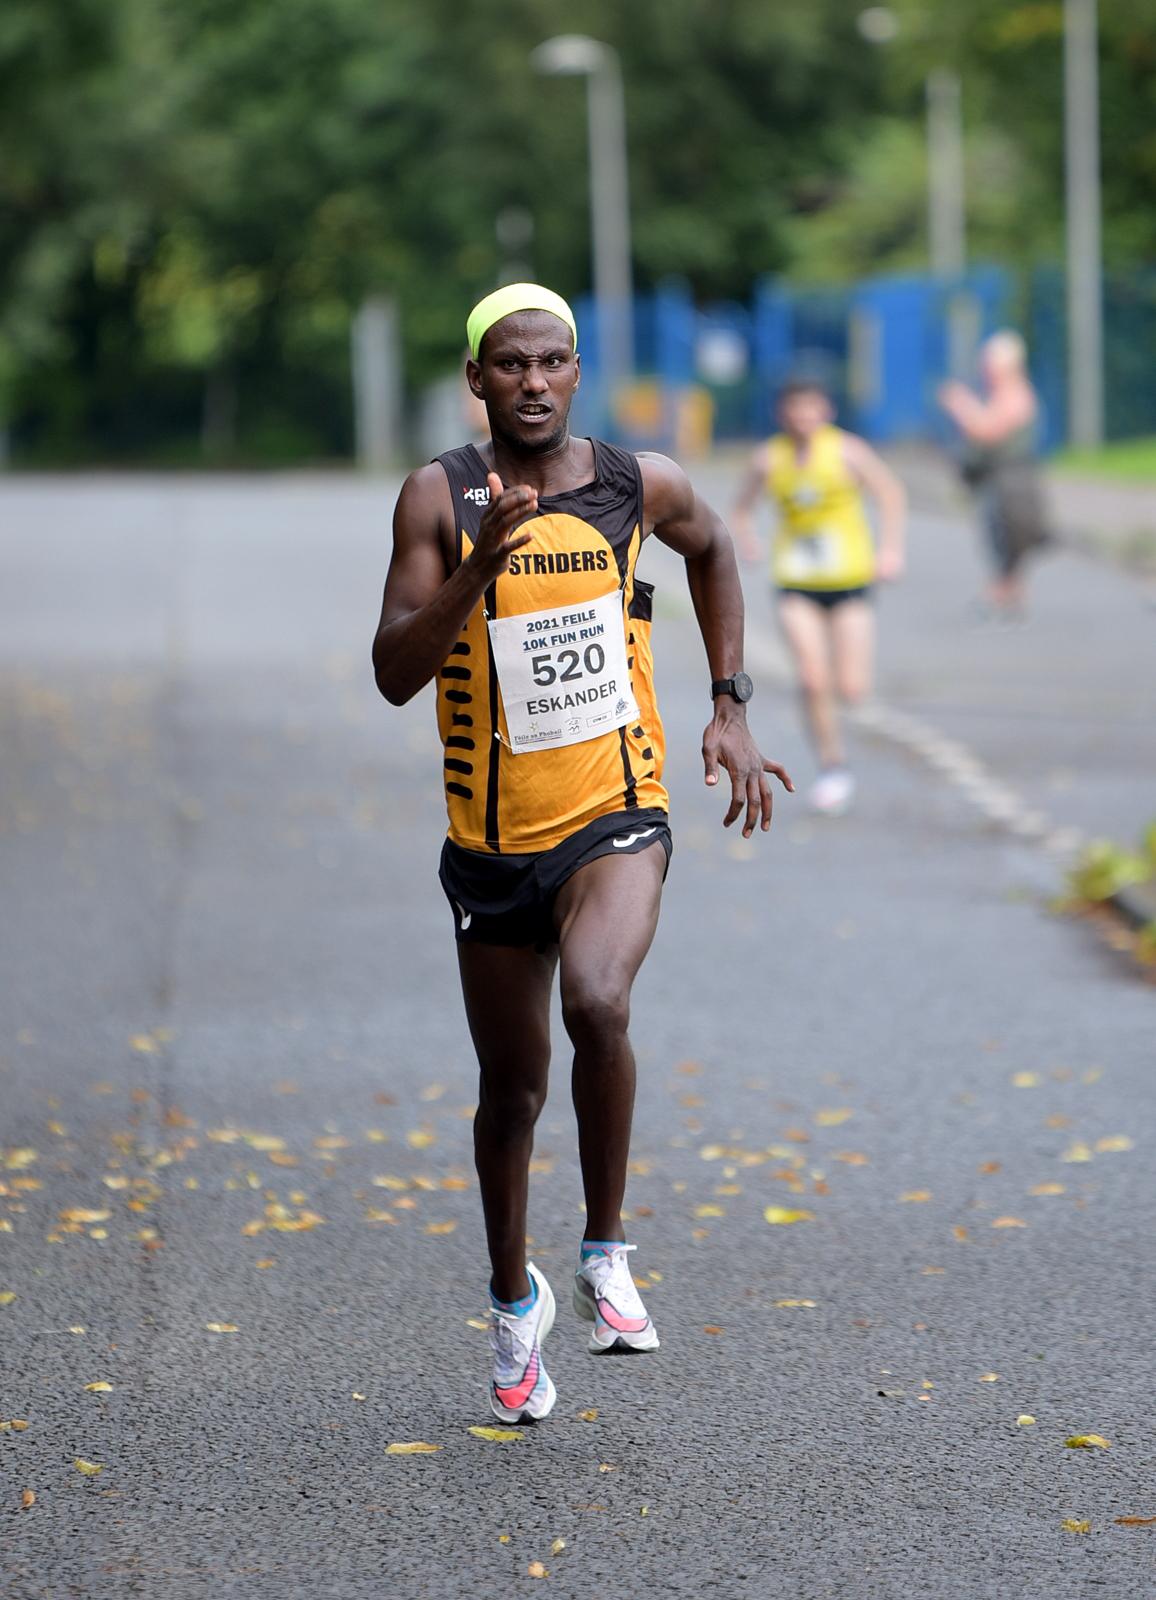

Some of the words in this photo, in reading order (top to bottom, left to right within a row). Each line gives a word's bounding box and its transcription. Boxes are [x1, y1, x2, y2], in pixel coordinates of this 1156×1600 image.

[508, 550, 608, 575] STRIDERS
[526, 618, 559, 633] 2021
[562, 609, 597, 626] FEILE
[522, 638, 548, 651] 10K
[551, 631, 577, 645] FUN
[580, 624, 604, 640] RUN
[531, 643, 605, 687] 520
[526, 680, 617, 715] ESKANDER
